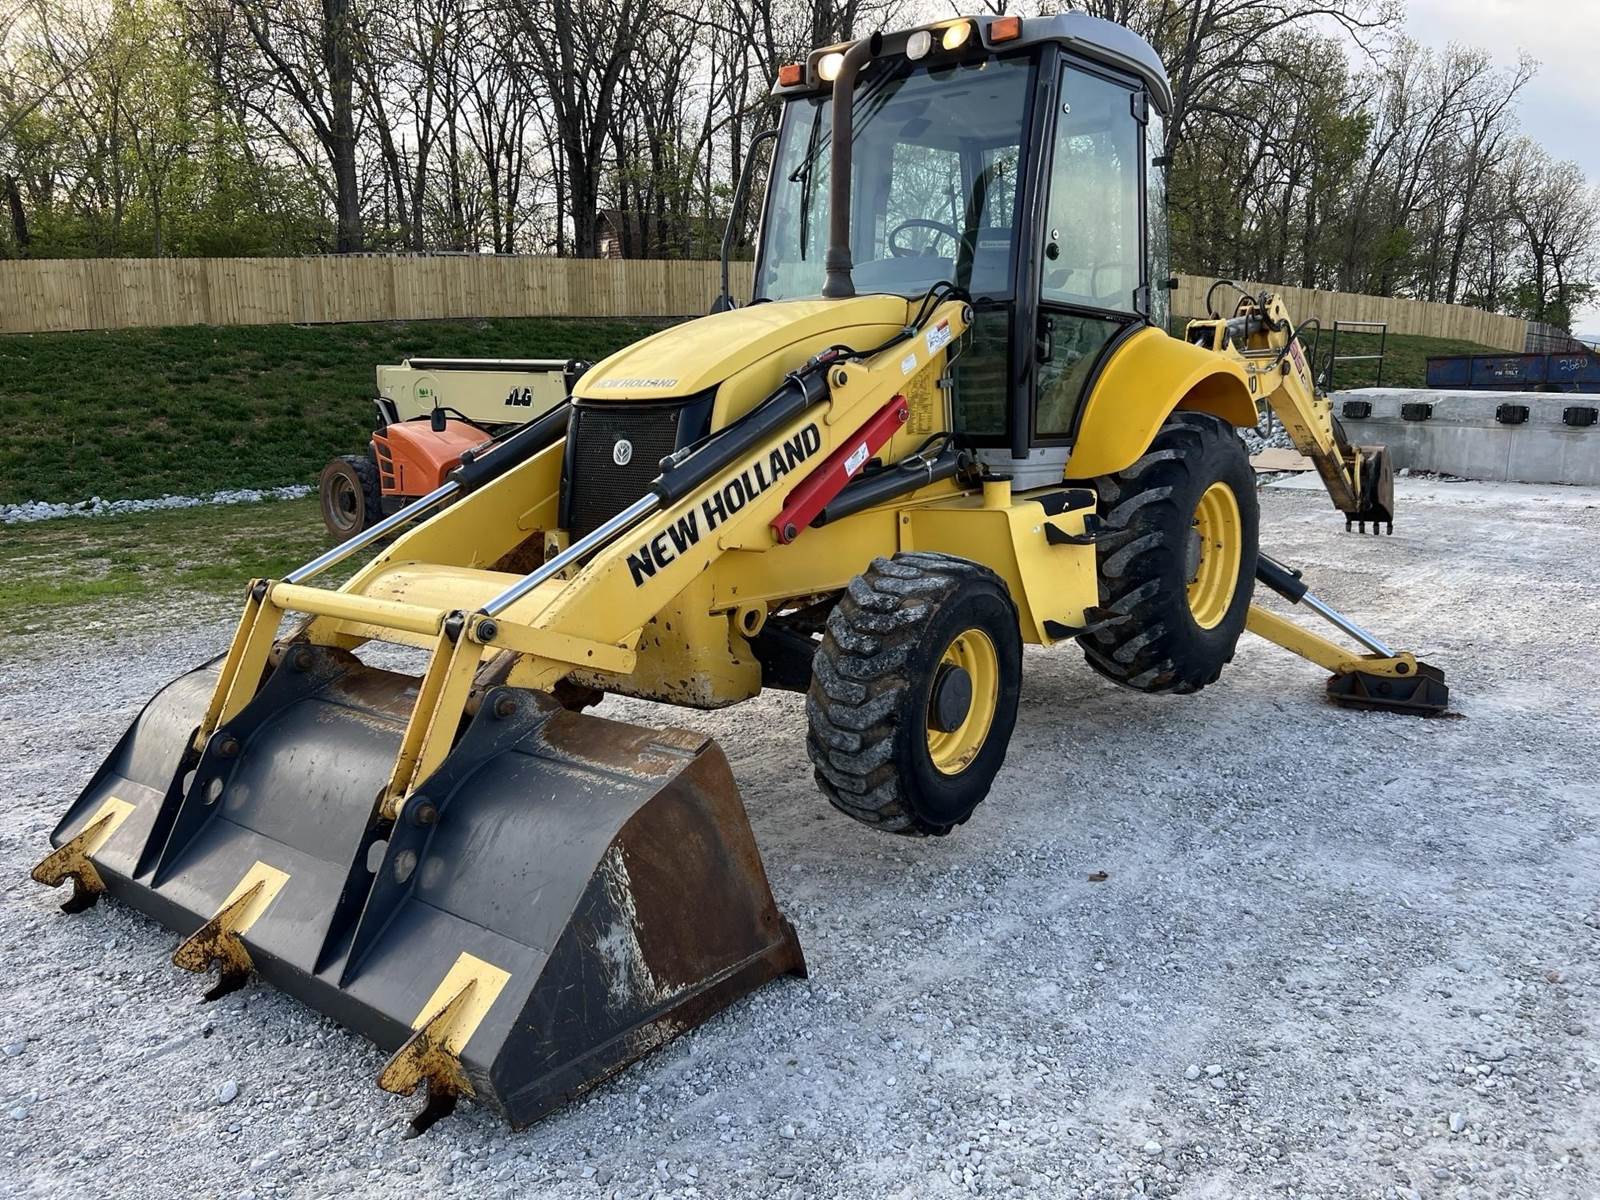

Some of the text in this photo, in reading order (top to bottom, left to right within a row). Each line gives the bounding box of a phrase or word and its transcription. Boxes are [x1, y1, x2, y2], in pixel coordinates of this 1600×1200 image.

[593, 378, 679, 388] NEW HOLLAND
[504, 387, 533, 407] JLG
[625, 422, 821, 588] NEW HOLLAND
